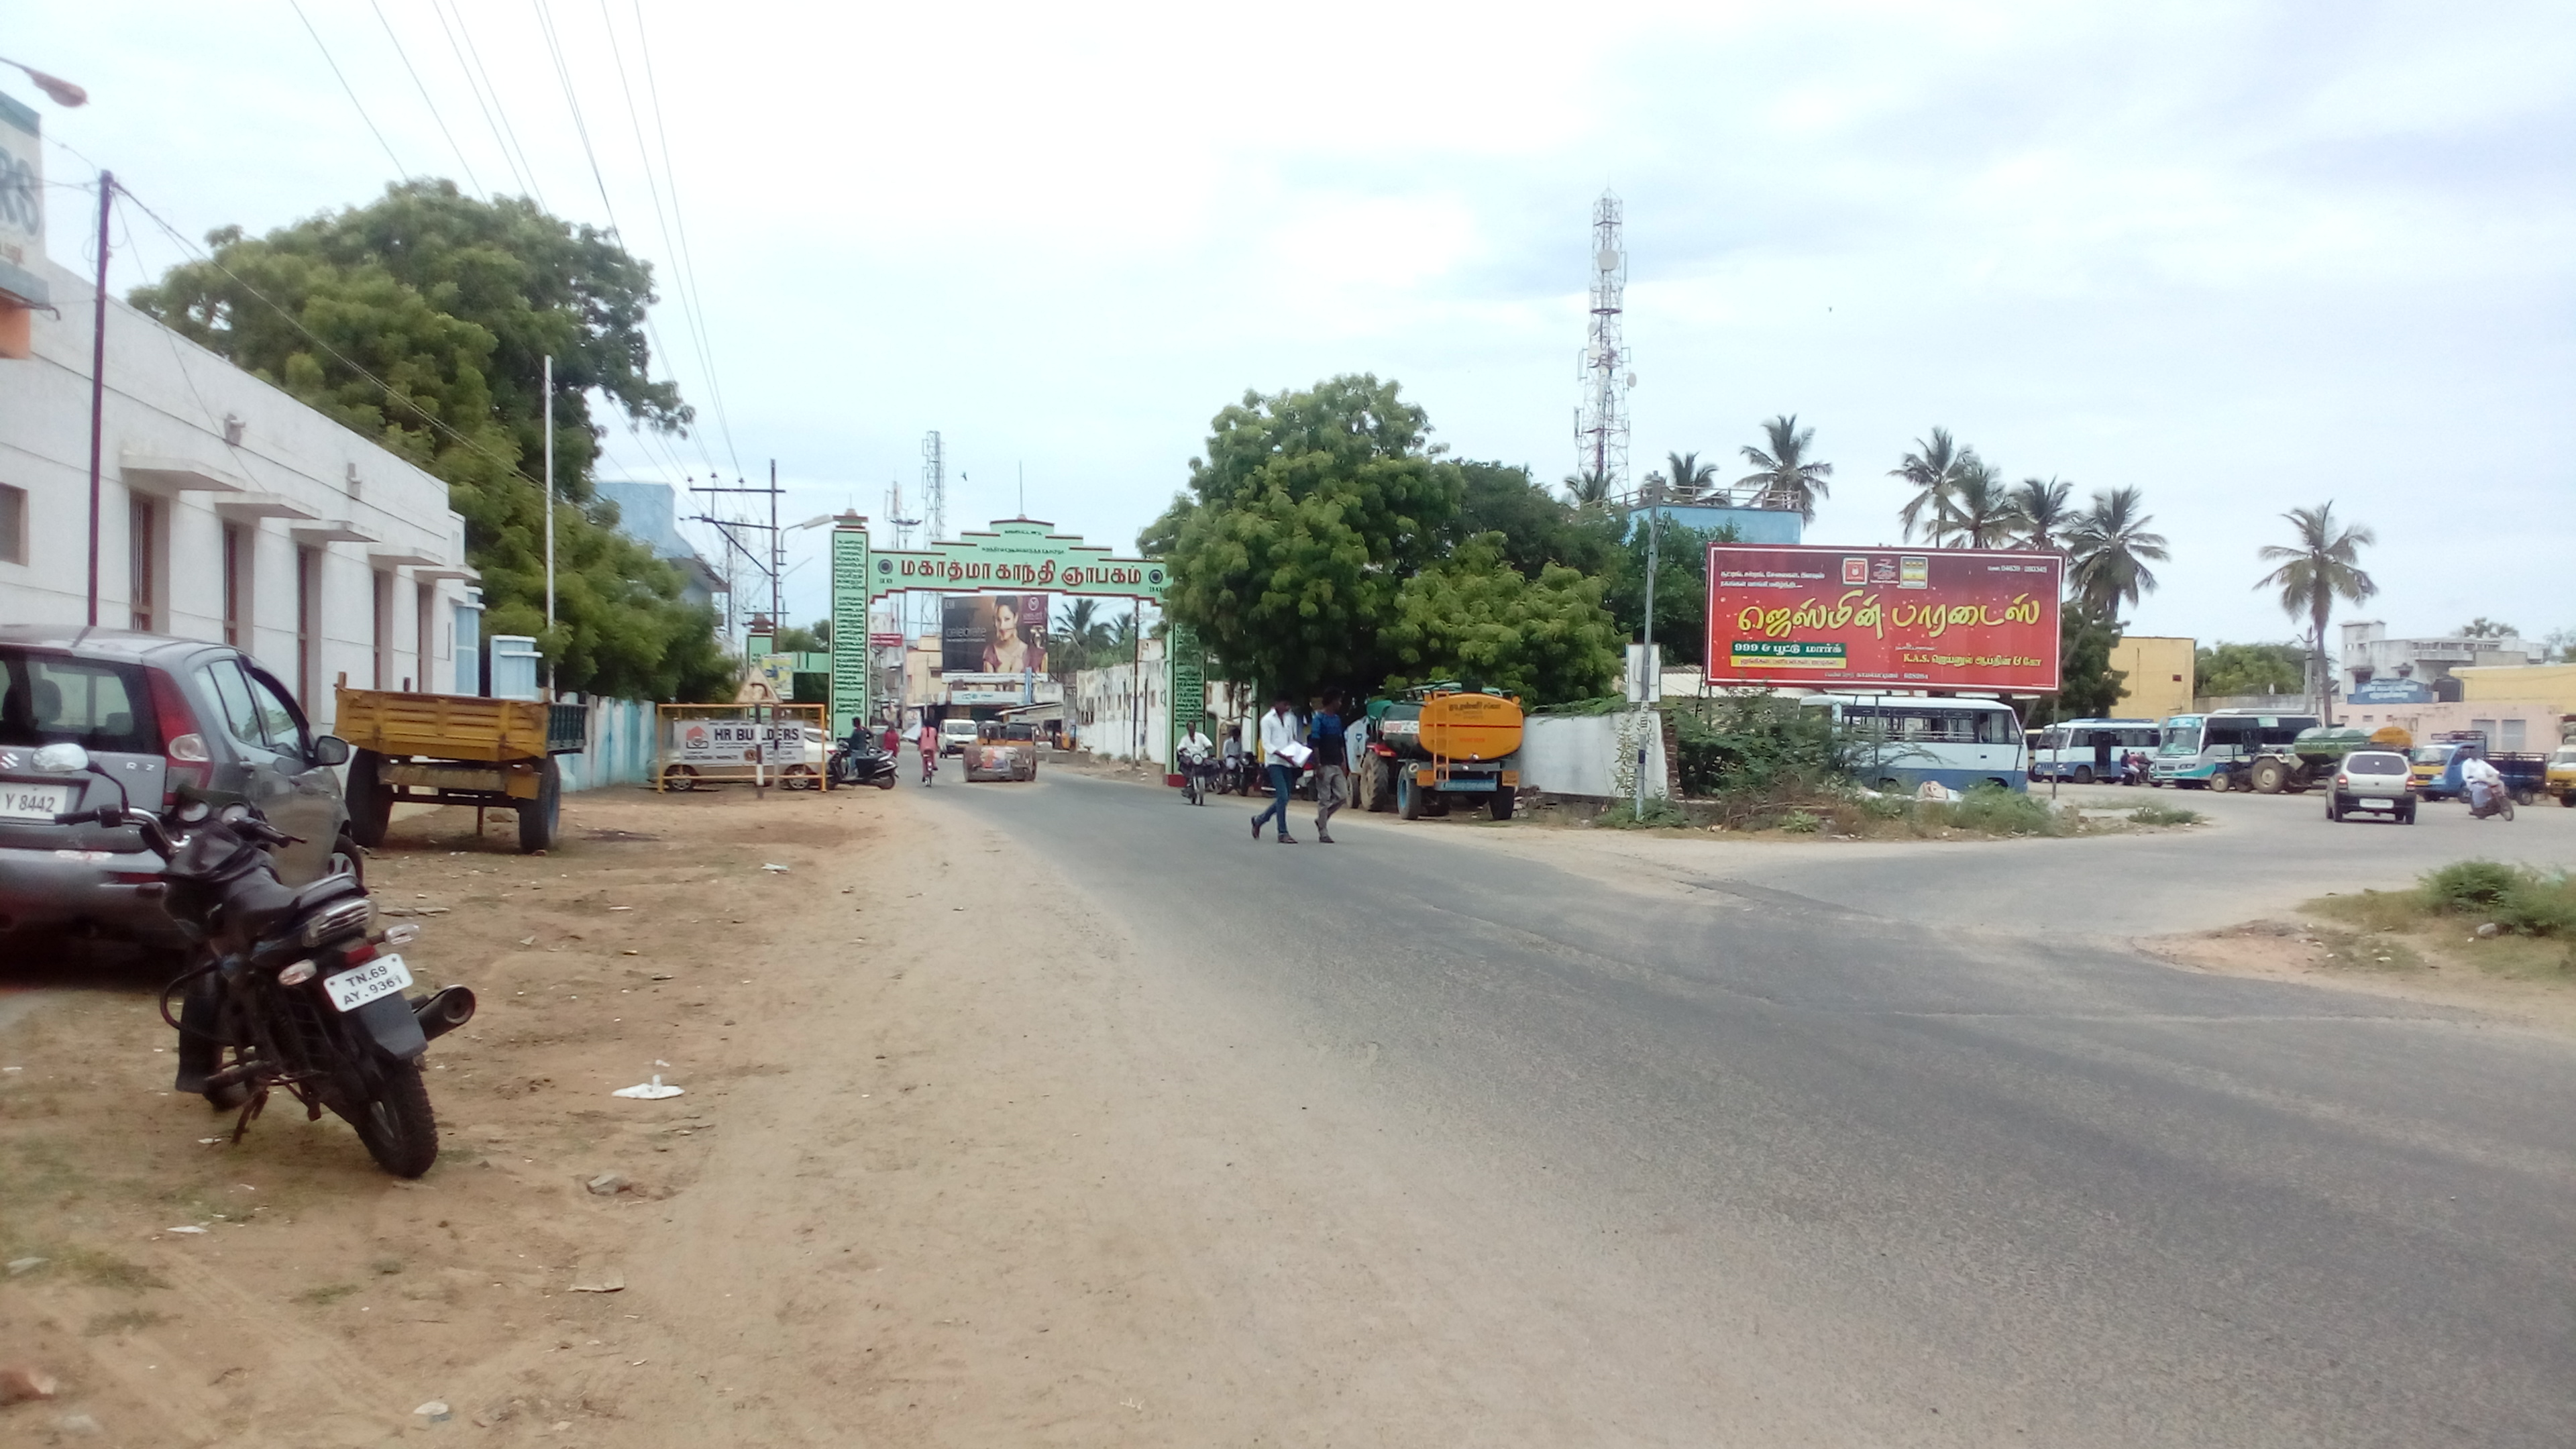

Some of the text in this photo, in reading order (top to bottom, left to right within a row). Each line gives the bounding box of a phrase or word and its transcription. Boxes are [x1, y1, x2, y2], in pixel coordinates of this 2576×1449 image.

[901, 559, 1141, 586] மகாத்மா காந்தி ஞாபகம்
[1737, 590, 2040, 639] ஜெஸ்மின் பாரடைஸ்
[1734, 643, 1758, 651] 999
[1761, 643, 1771, 652] &
[1903, 653, 1929, 663] K.A.S.
[714, 729, 799, 741] HR BUDERS
[19, 794, 55, 812] 8442
[345, 965, 387, 987] TN.69
